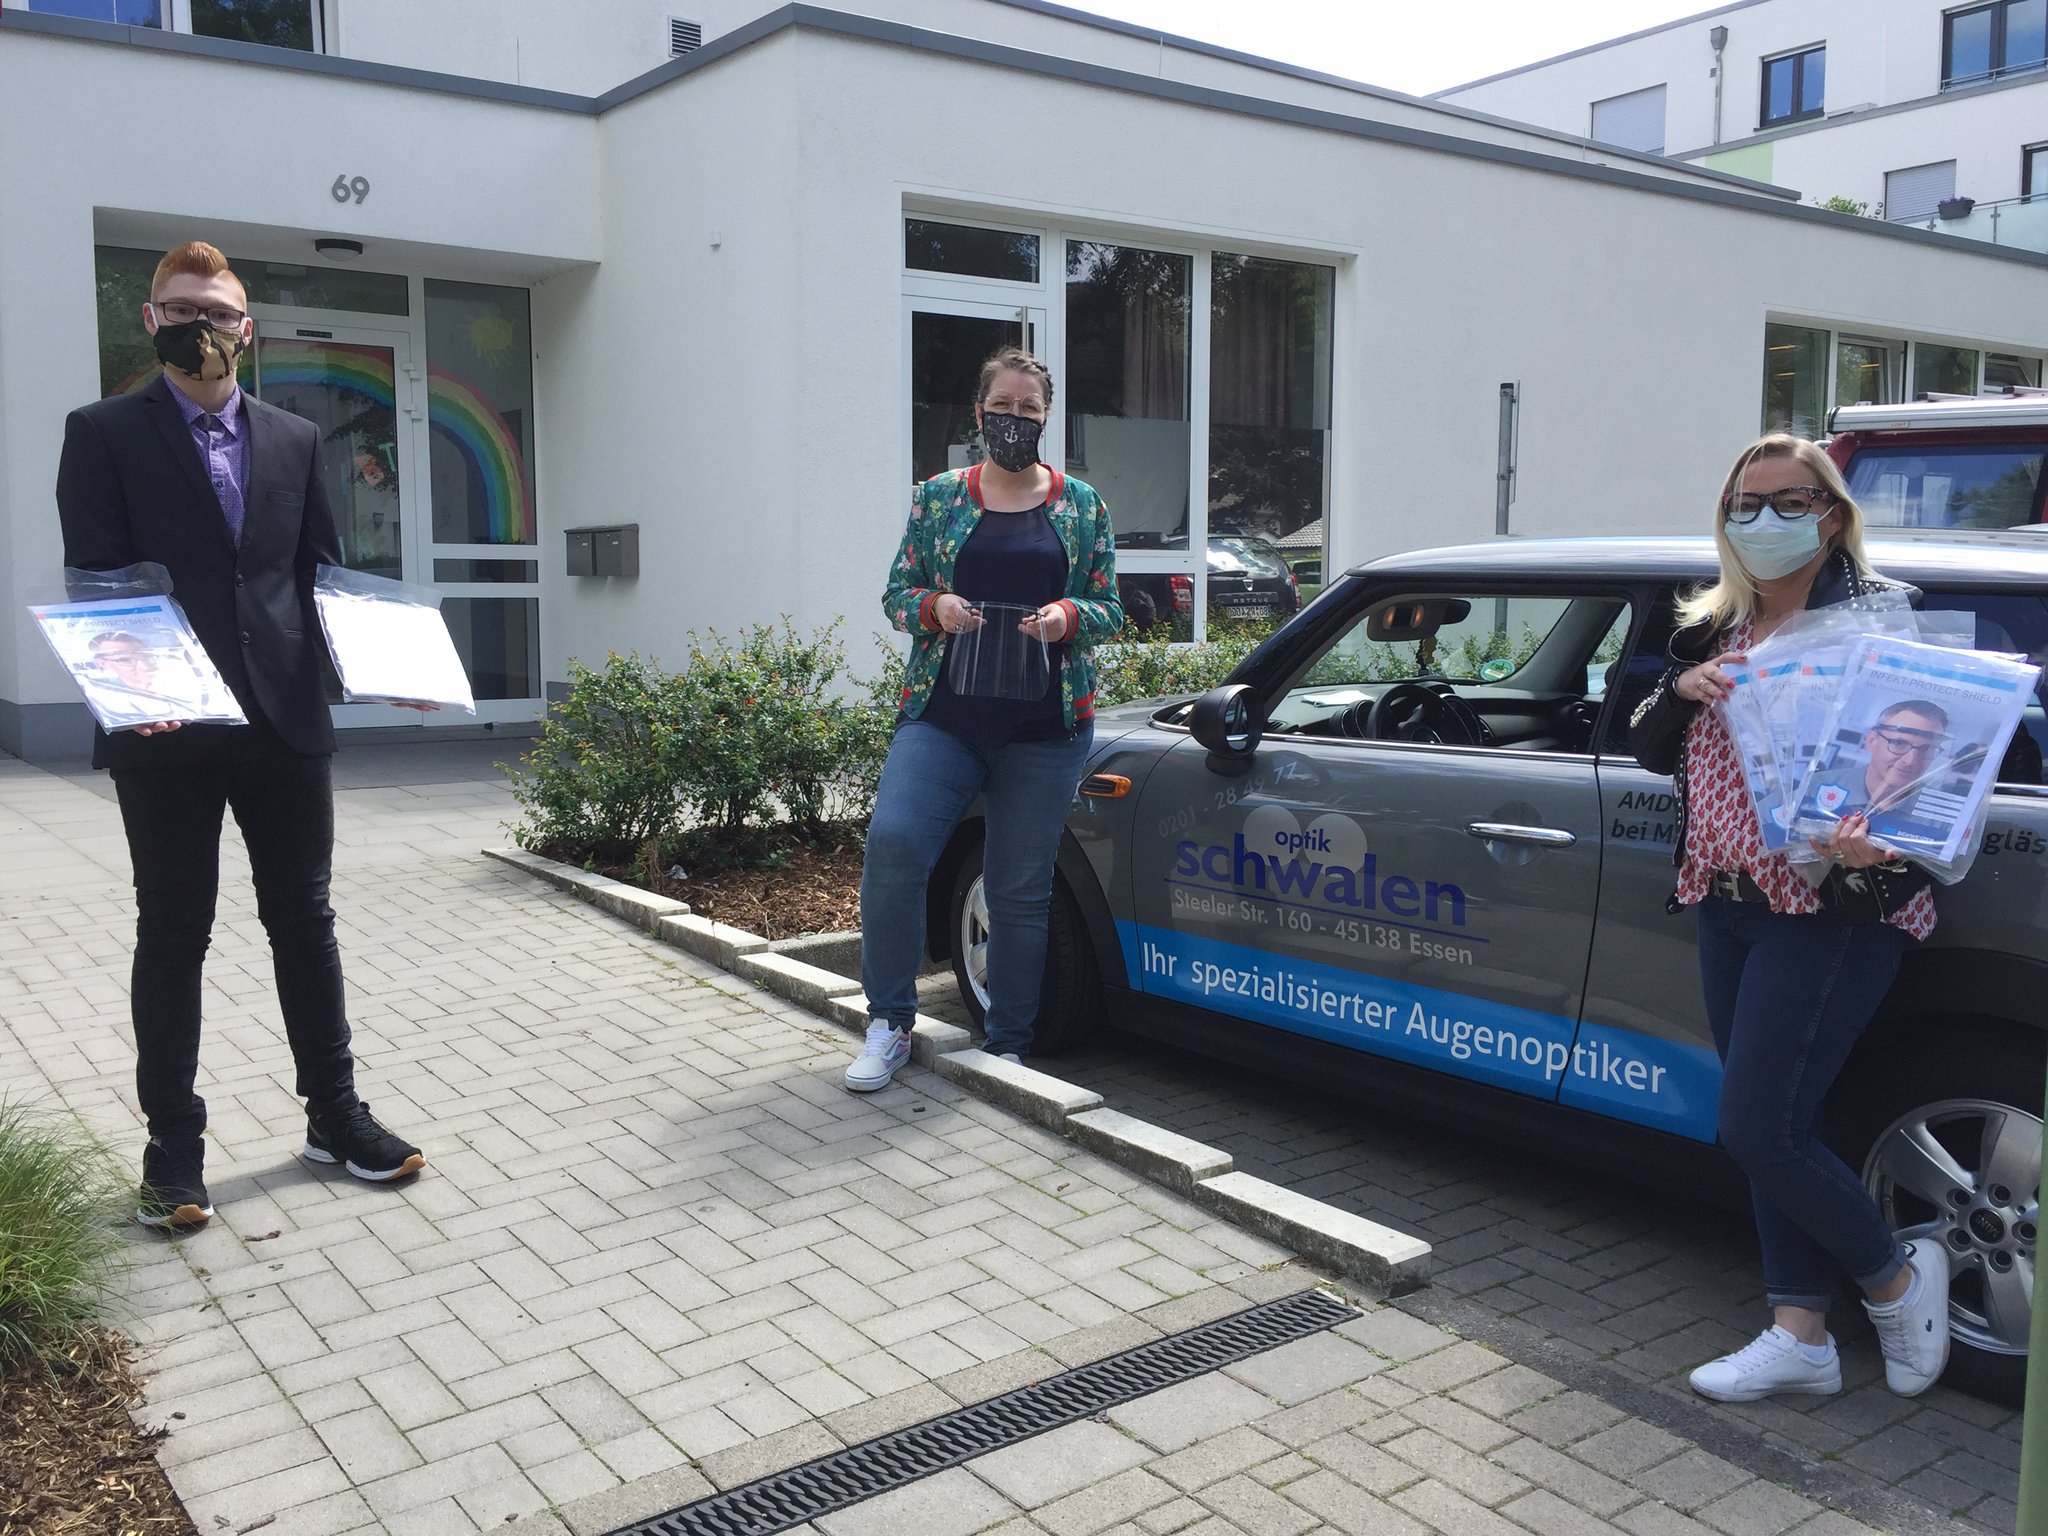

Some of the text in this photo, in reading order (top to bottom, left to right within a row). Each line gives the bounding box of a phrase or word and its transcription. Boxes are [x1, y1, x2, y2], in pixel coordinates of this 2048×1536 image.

[331, 174, 370, 204] 69
[1870, 670, 1959, 697] INFEKT-PROTECT
[1961, 687, 2002, 705] SHIELD
[1158, 806, 1196, 838] 0201
[1214, 787, 1237, 811] 28
[1243, 775, 1265, 794] 49
[1617, 790, 1673, 812] AMD
[1275, 828, 1332, 853] optik
[1611, 818, 1648, 841] bei
[1176, 832, 1466, 927] schwalen
[1175, 890, 1234, 917] Steeler
[1241, 900, 1269, 925] Str.
[1276, 907, 1312, 932] 160
[1334, 918, 1401, 950] 45138
[1409, 932, 1473, 965] Essen
[1143, 942, 1667, 1094] Ihr spezialisierter Augenoptiker
